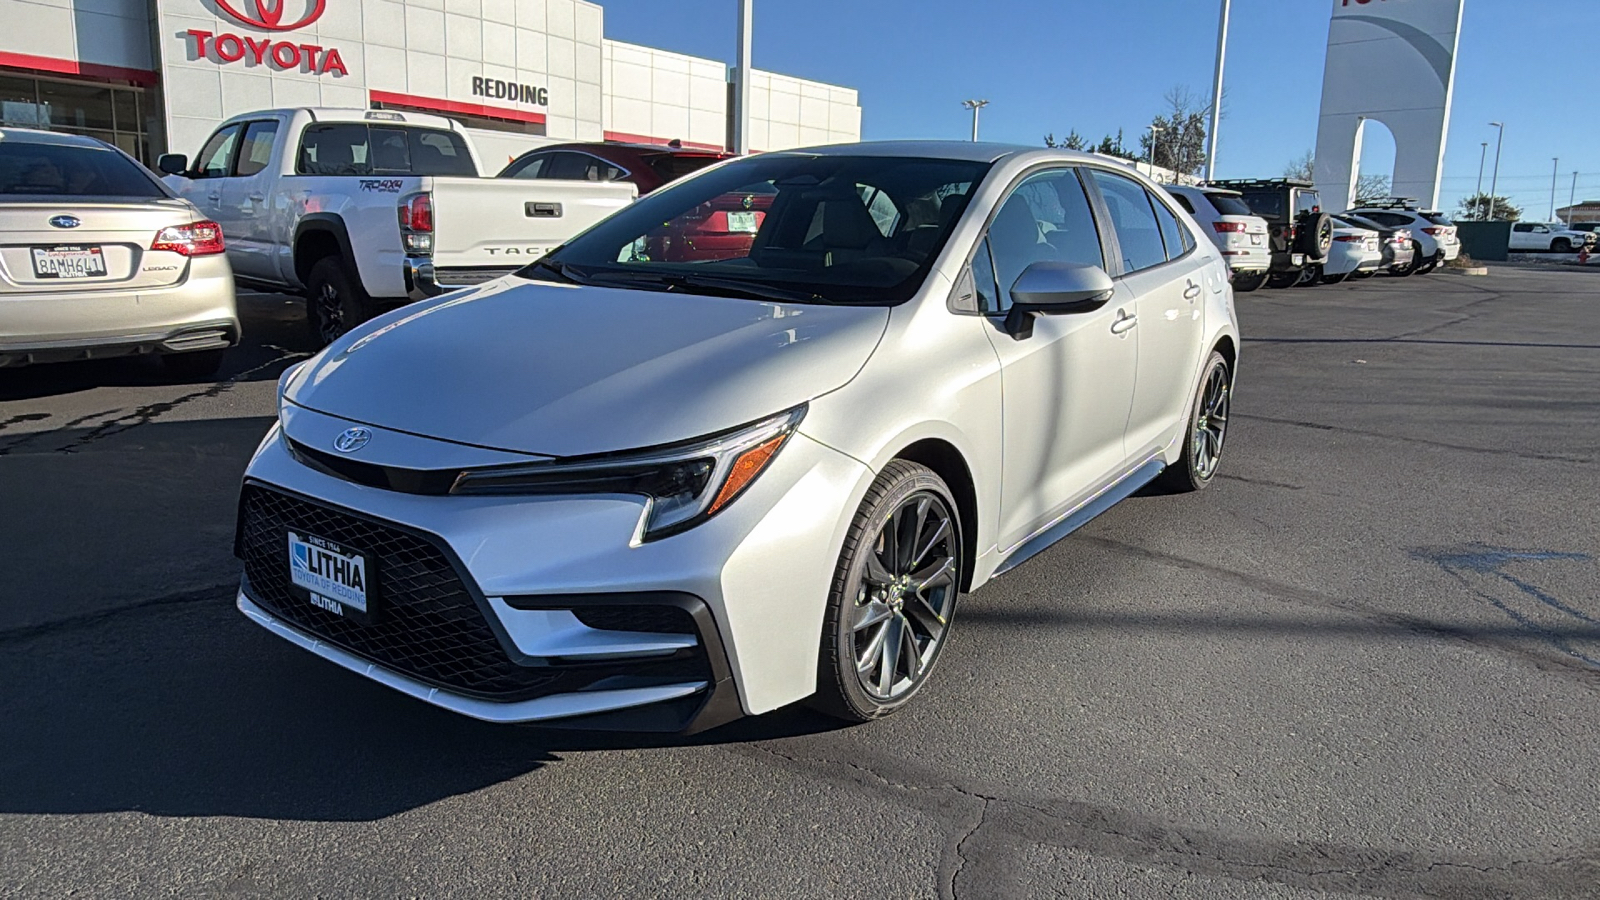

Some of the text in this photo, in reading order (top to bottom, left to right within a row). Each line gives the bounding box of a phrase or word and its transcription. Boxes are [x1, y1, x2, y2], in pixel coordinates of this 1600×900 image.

[188, 29, 349, 76] TOYOTA
[472, 76, 548, 106] REDDING
[39, 258, 99, 273] 8AMH641
[308, 535, 326, 548] SINCE
[307, 546, 365, 593] LITHIA
[293, 568, 366, 605] TOYOTA OF REDDING
[317, 594, 344, 617] LITHIA
